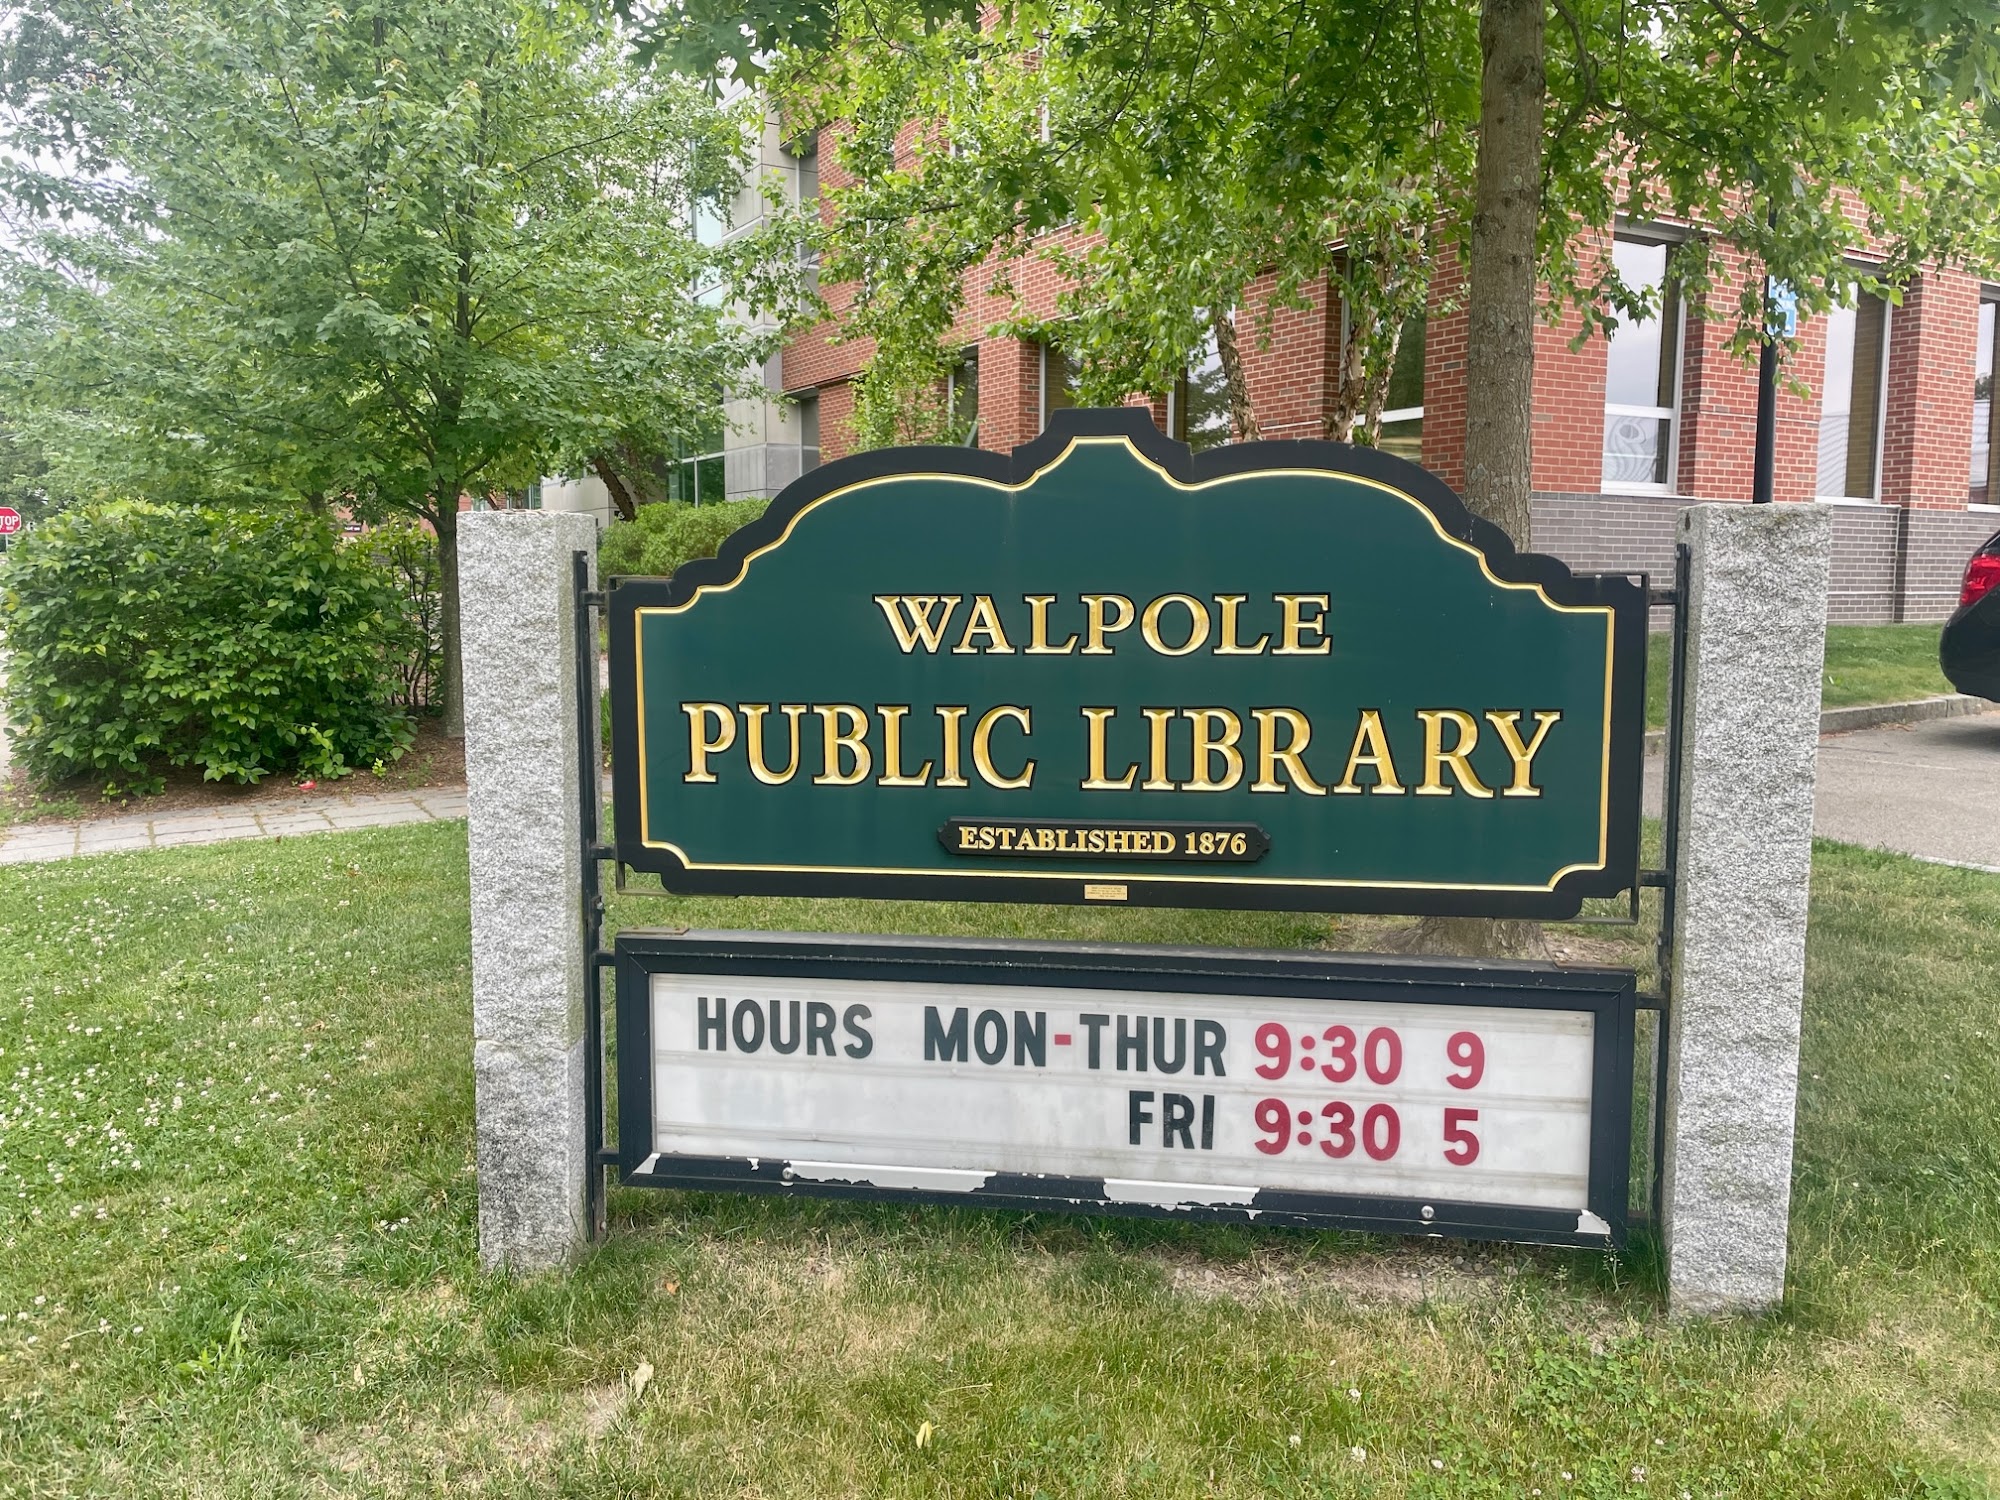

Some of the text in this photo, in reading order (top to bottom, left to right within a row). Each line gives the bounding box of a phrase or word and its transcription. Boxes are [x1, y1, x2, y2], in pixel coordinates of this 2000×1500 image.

[0, 515, 19, 526] TOP
[874, 594, 1331, 656] WALPOLE
[681, 703, 1562, 799] PUBLIC LIBRARY
[958, 826, 1247, 856] ESTABLISHED 1876
[697, 997, 1485, 1090] HOURS MON-THUR 9:30 9
[1129, 1090, 1480, 1166] FRI 9:30 5
